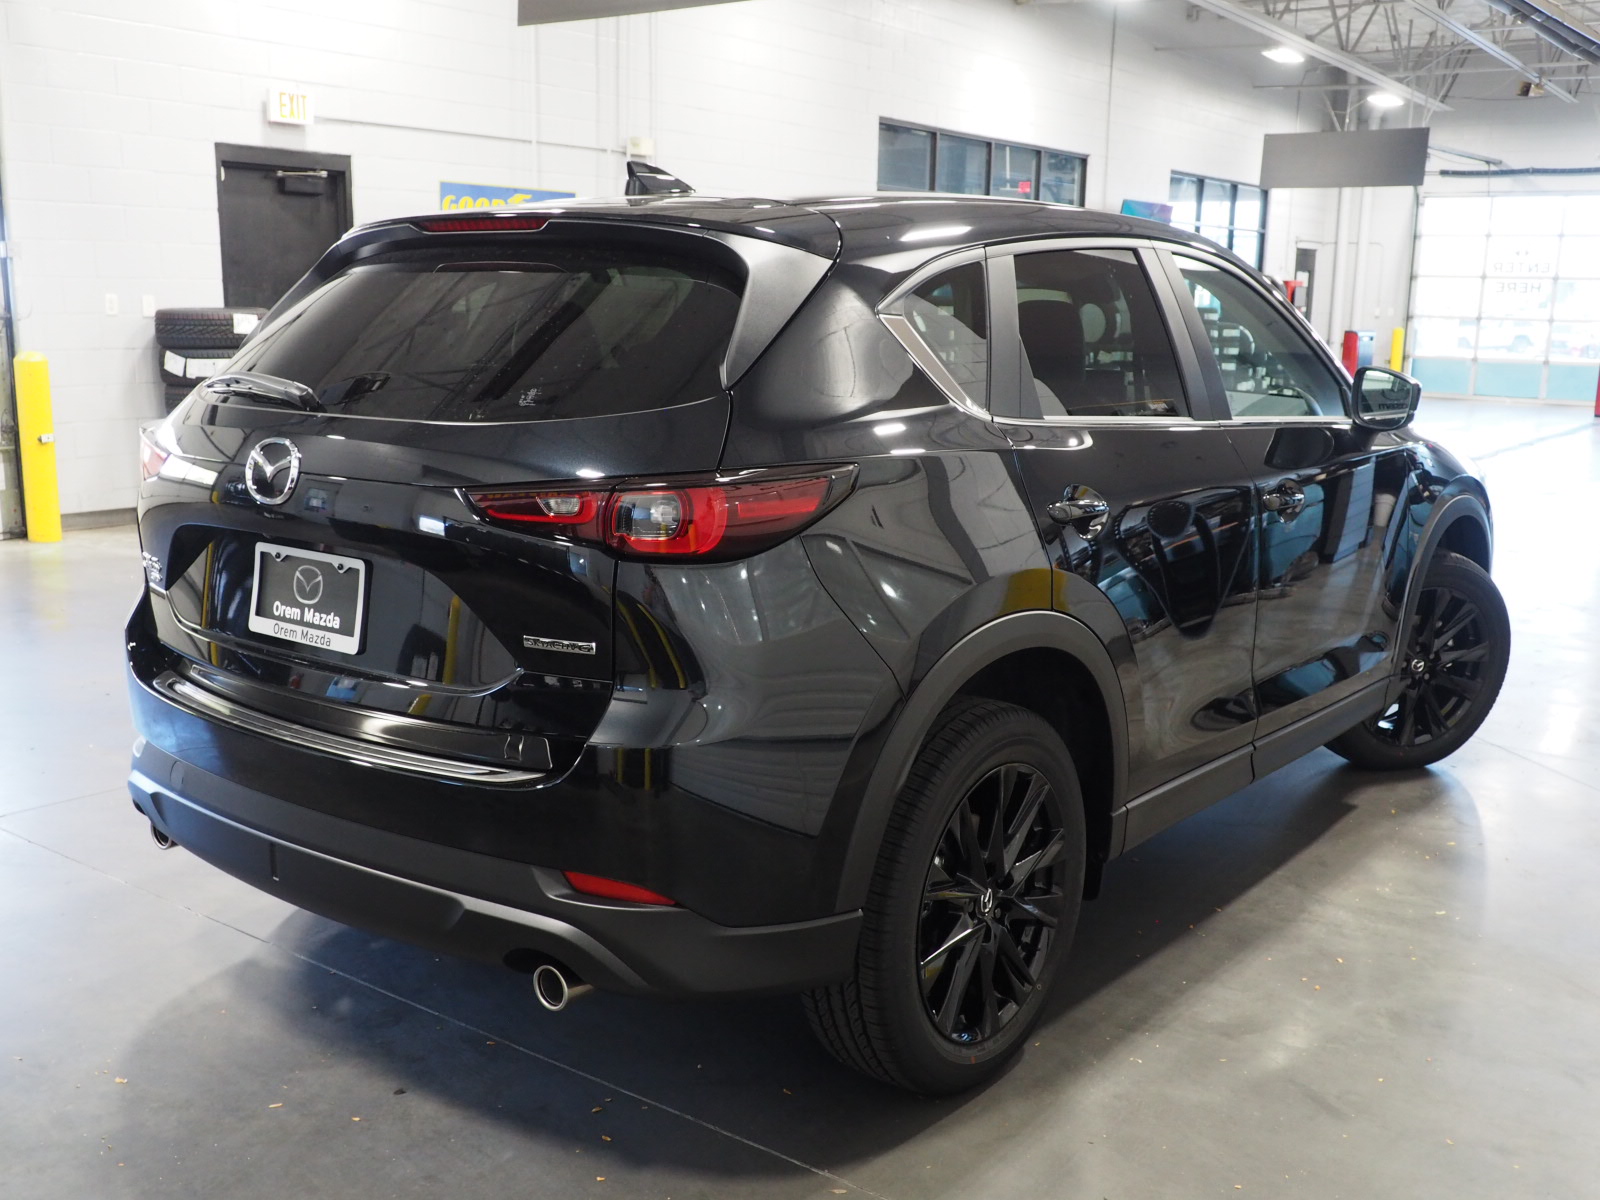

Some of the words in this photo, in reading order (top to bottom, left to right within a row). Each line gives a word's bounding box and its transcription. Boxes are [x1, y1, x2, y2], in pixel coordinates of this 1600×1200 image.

[279, 92, 307, 120] EXIT
[273, 601, 301, 621] Orem
[304, 607, 341, 629] Mazda
[273, 623, 298, 640] Orem
[300, 628, 331, 647] Mazda
